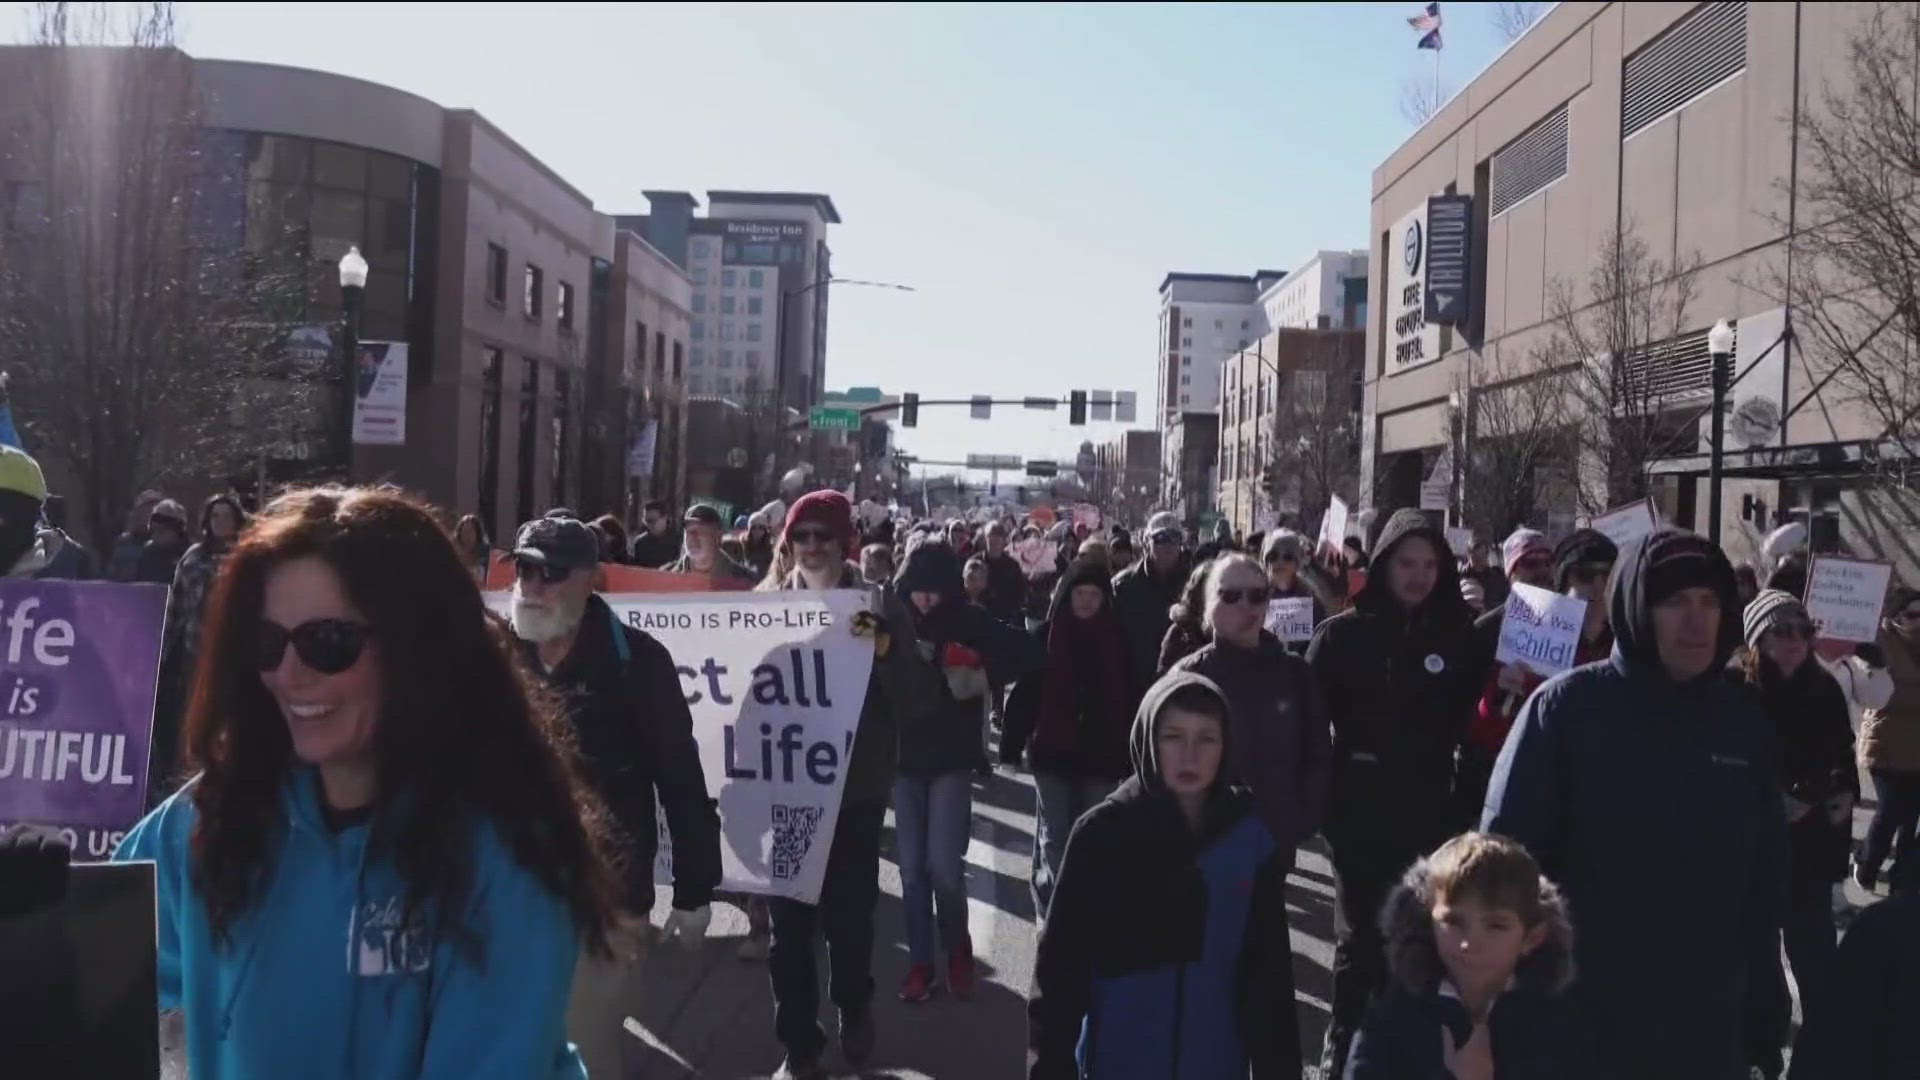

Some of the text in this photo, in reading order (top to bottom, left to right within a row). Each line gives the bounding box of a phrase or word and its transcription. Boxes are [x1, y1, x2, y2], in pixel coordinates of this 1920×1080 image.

[1429, 202, 1465, 292] TRILLIUM
[0, 597, 75, 666] fe
[8, 677, 40, 714] is
[752, 648, 832, 708] all
